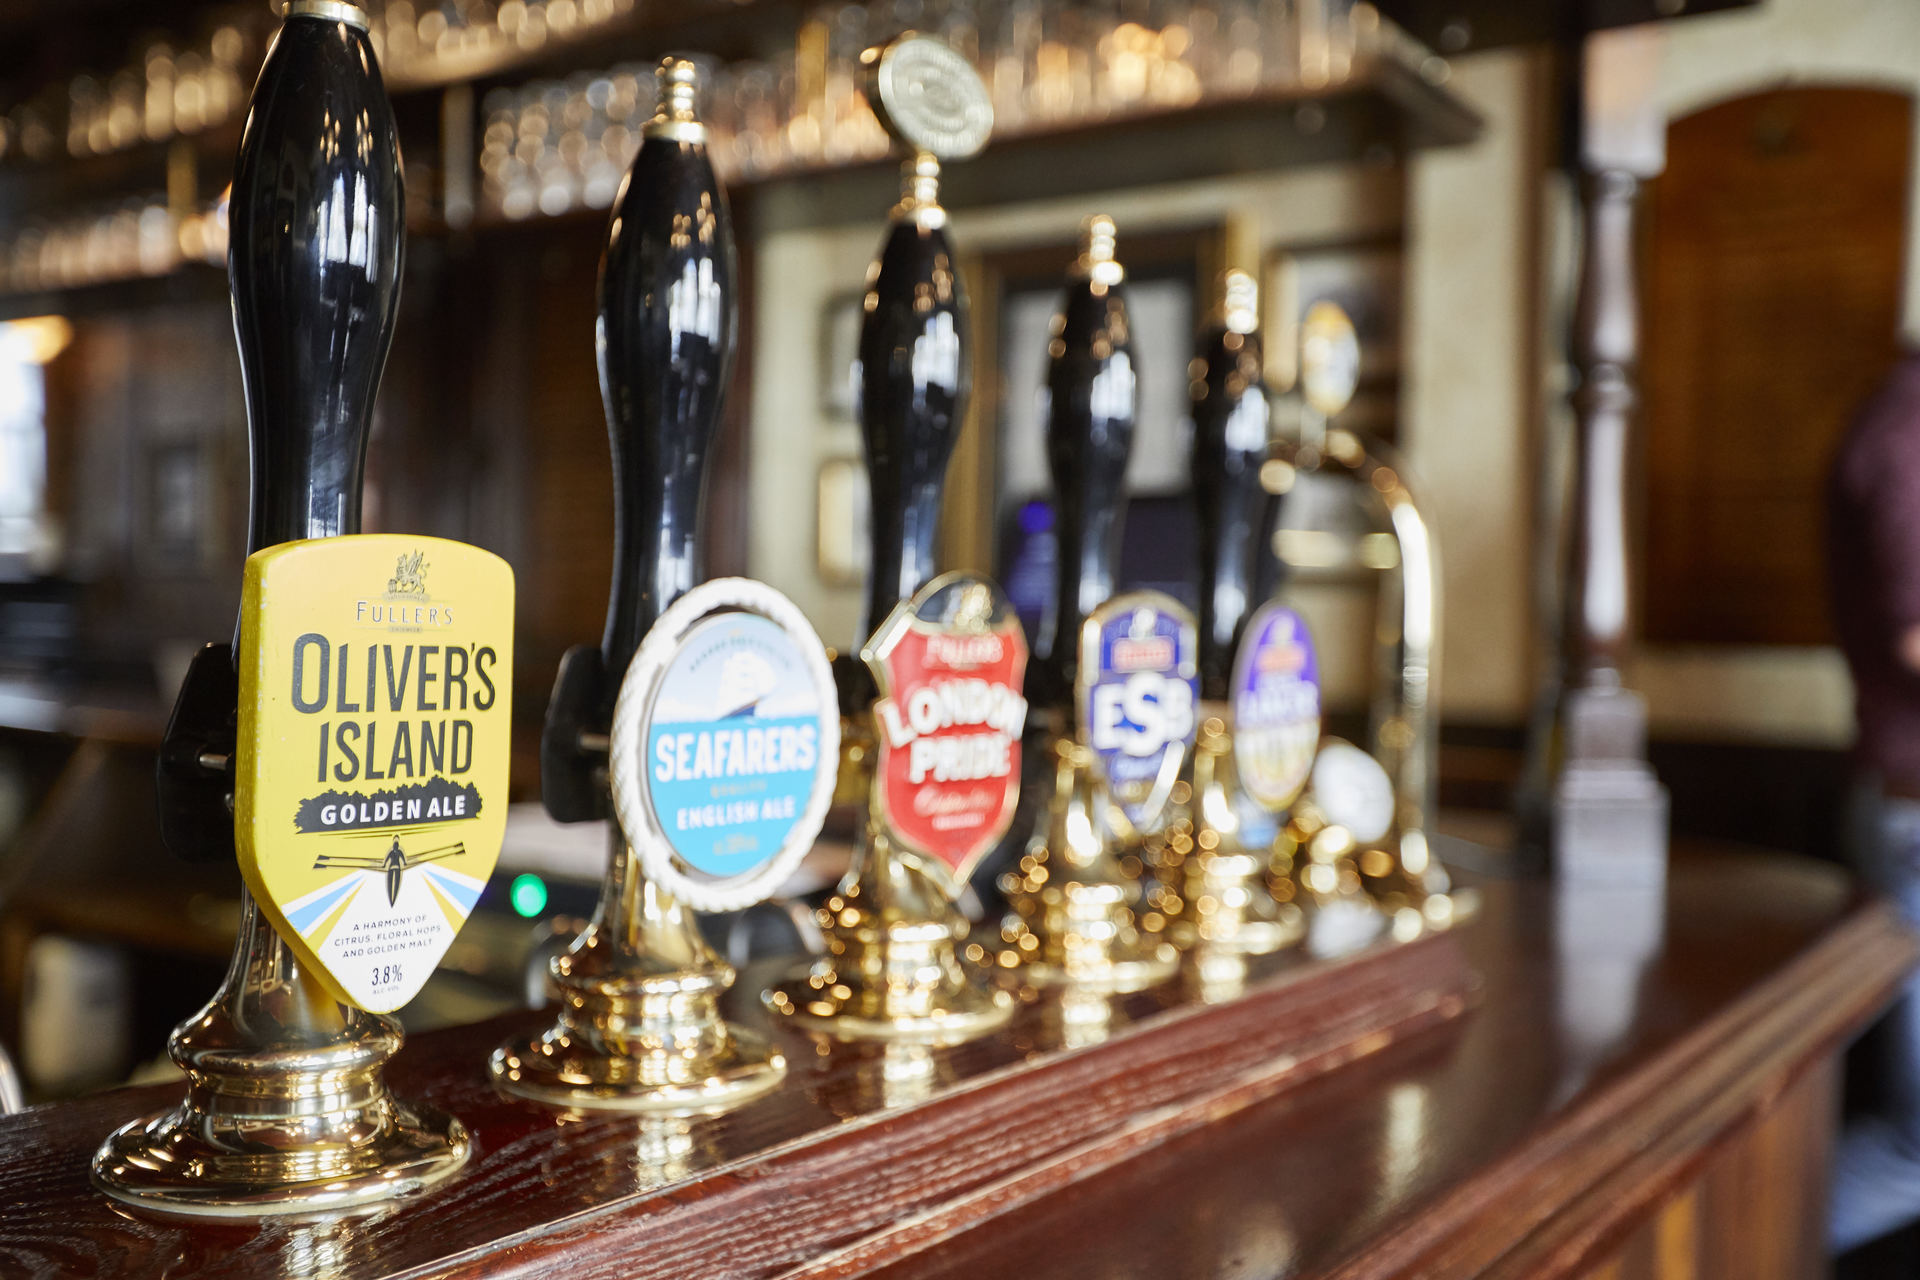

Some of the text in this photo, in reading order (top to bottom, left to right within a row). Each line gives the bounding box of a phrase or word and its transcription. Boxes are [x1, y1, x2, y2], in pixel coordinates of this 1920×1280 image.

[357, 601, 453, 625] FULLER'S
[291, 633, 496, 714] OLIVER'S
[879, 679, 1028, 748] LONDON
[1095, 672, 1193, 757] ESB
[318, 720, 473, 783] ISLAND
[655, 725, 817, 782] SEAFARERS
[910, 734, 1010, 785] PRIDE
[320, 795, 467, 825] GOLDEN ALE
[676, 795, 795, 830] ENGLISH ALE
[363, 918, 412, 930] HARMONY
[415, 914, 427, 924] OF
[377, 930, 414, 941] FLORAL
[416, 925, 441, 935] HOPS
[342, 939, 433, 958] AND GOLDEN MALT
[371, 964, 403, 986] 3.8%
